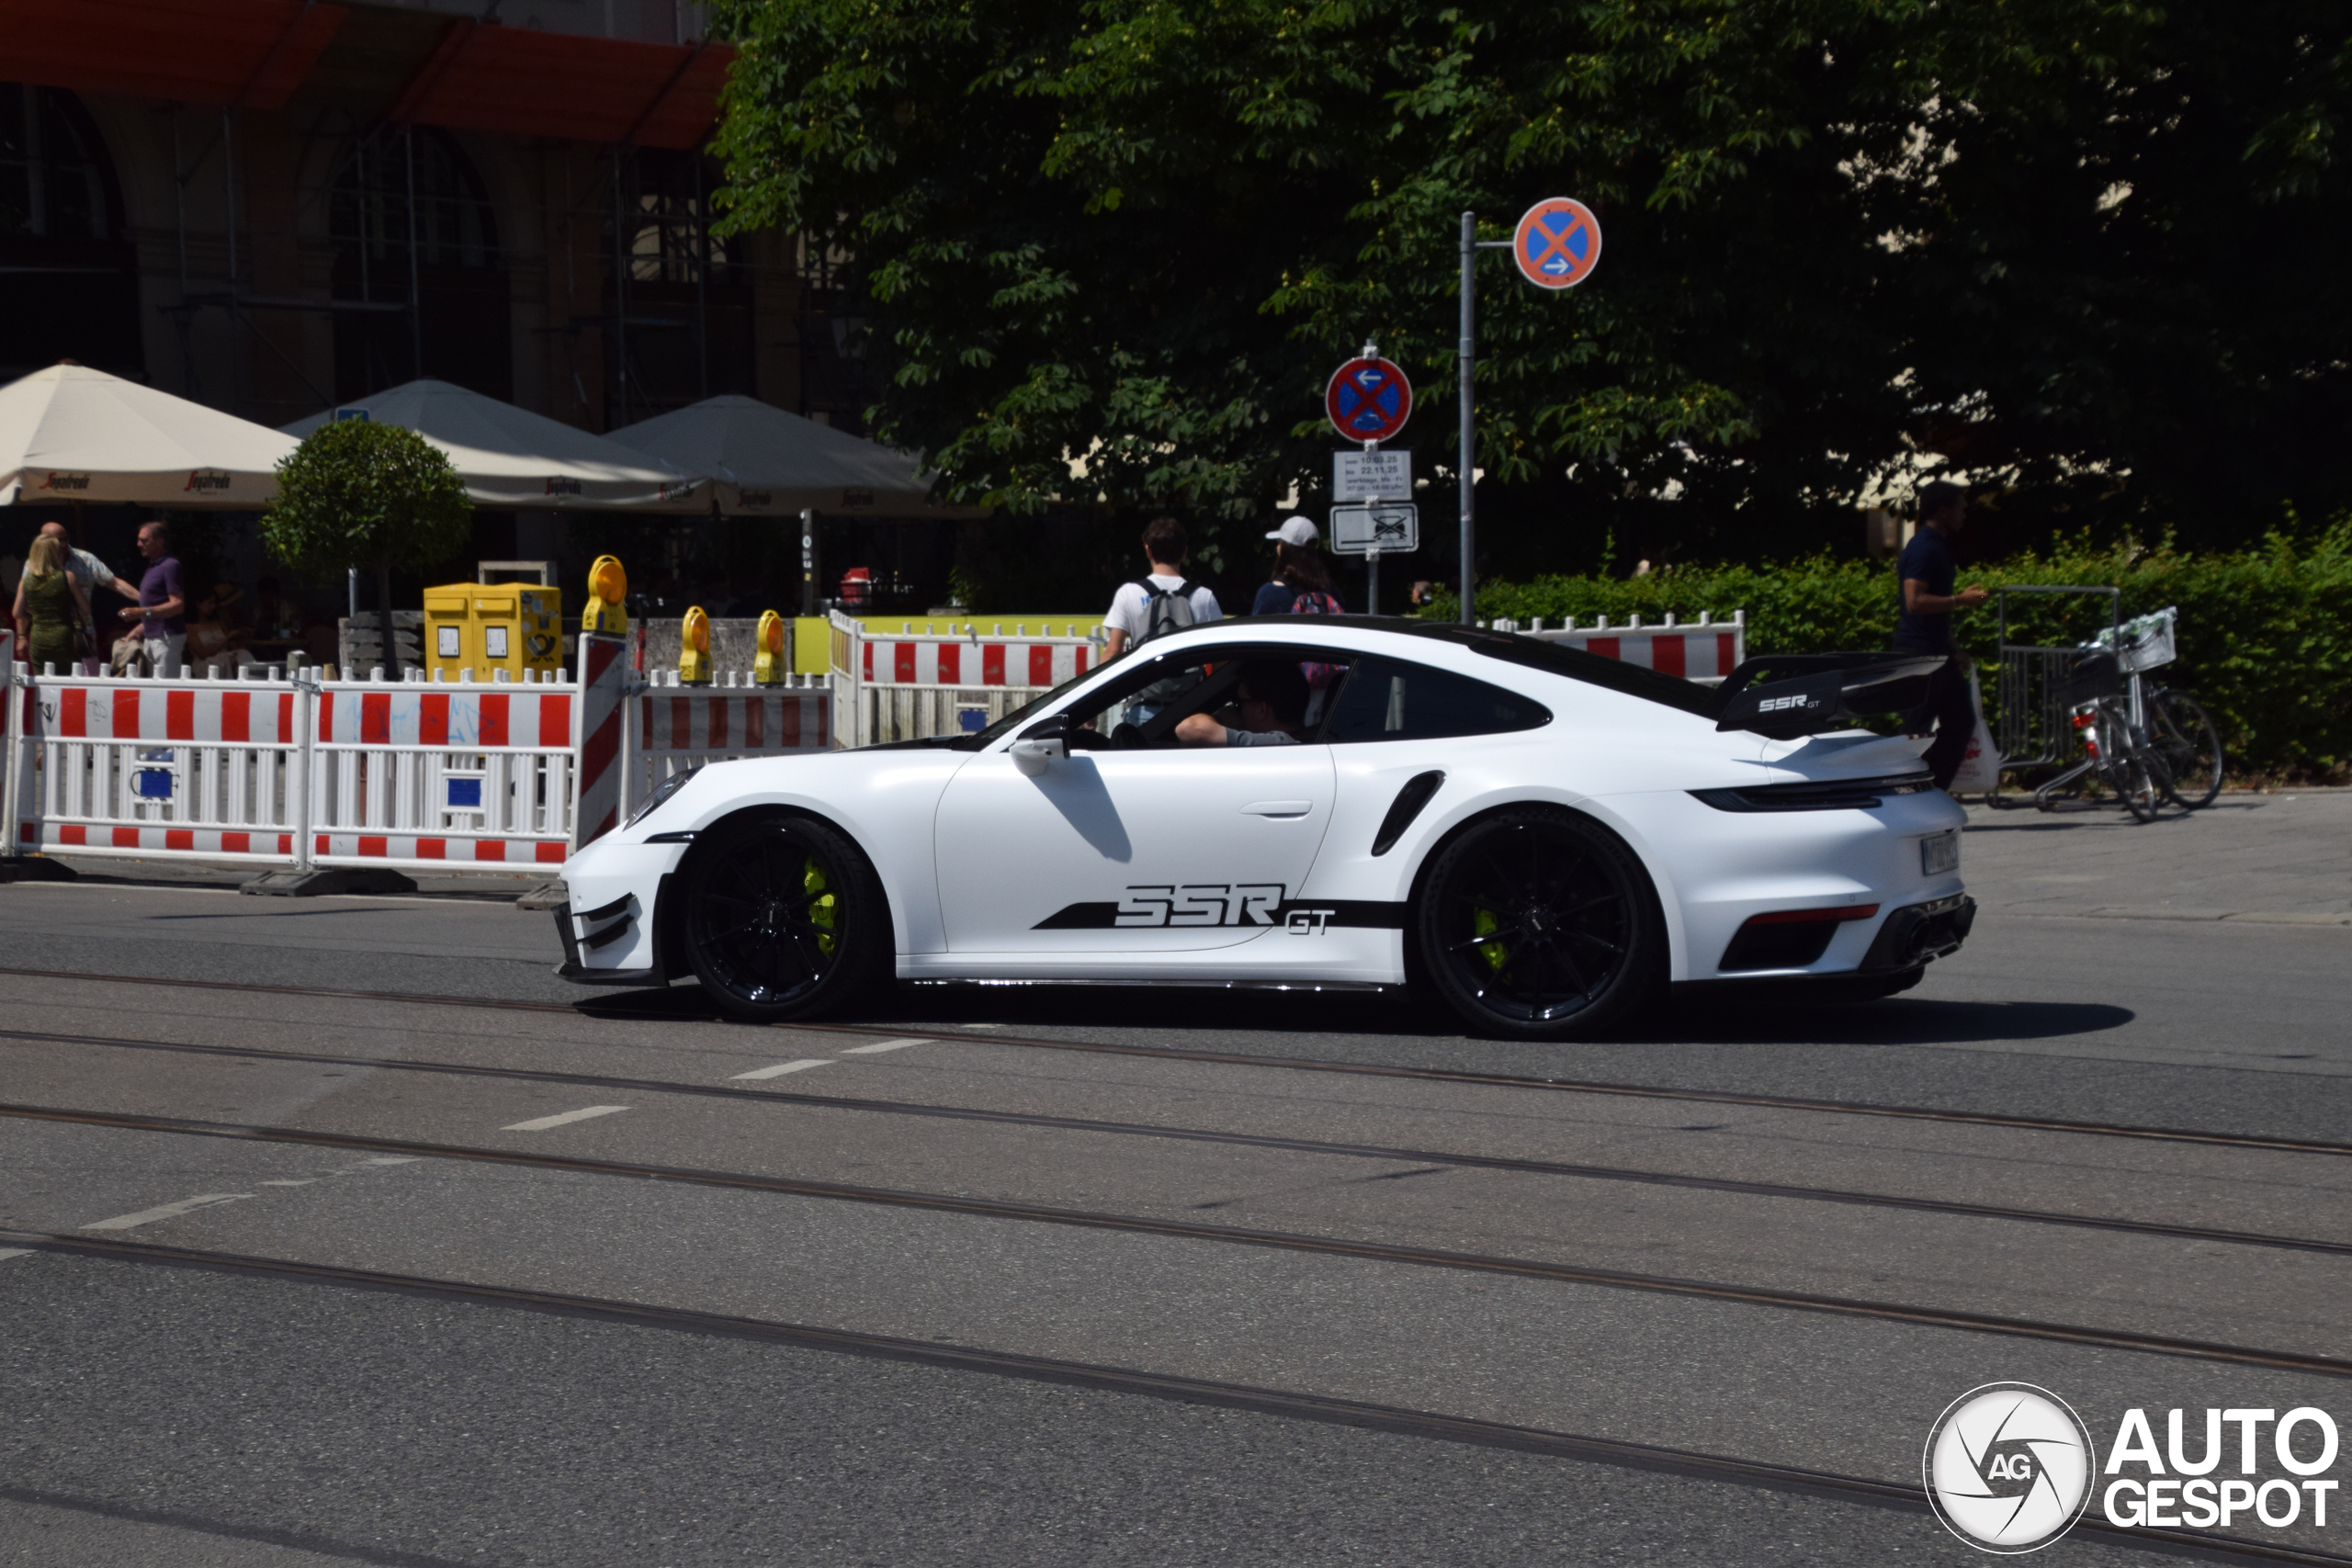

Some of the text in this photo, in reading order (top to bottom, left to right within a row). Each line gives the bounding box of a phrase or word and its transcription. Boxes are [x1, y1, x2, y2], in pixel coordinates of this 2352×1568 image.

[1361, 456, 1397, 464] 10.03.25
[1361, 466, 1398, 474] 22.11.25
[39, 472, 90, 489] Segafredo
[184, 470, 231, 491] Segafredo
[1758, 694, 1821, 713] SSR GT
[1114, 884, 1336, 935] SSR GT
